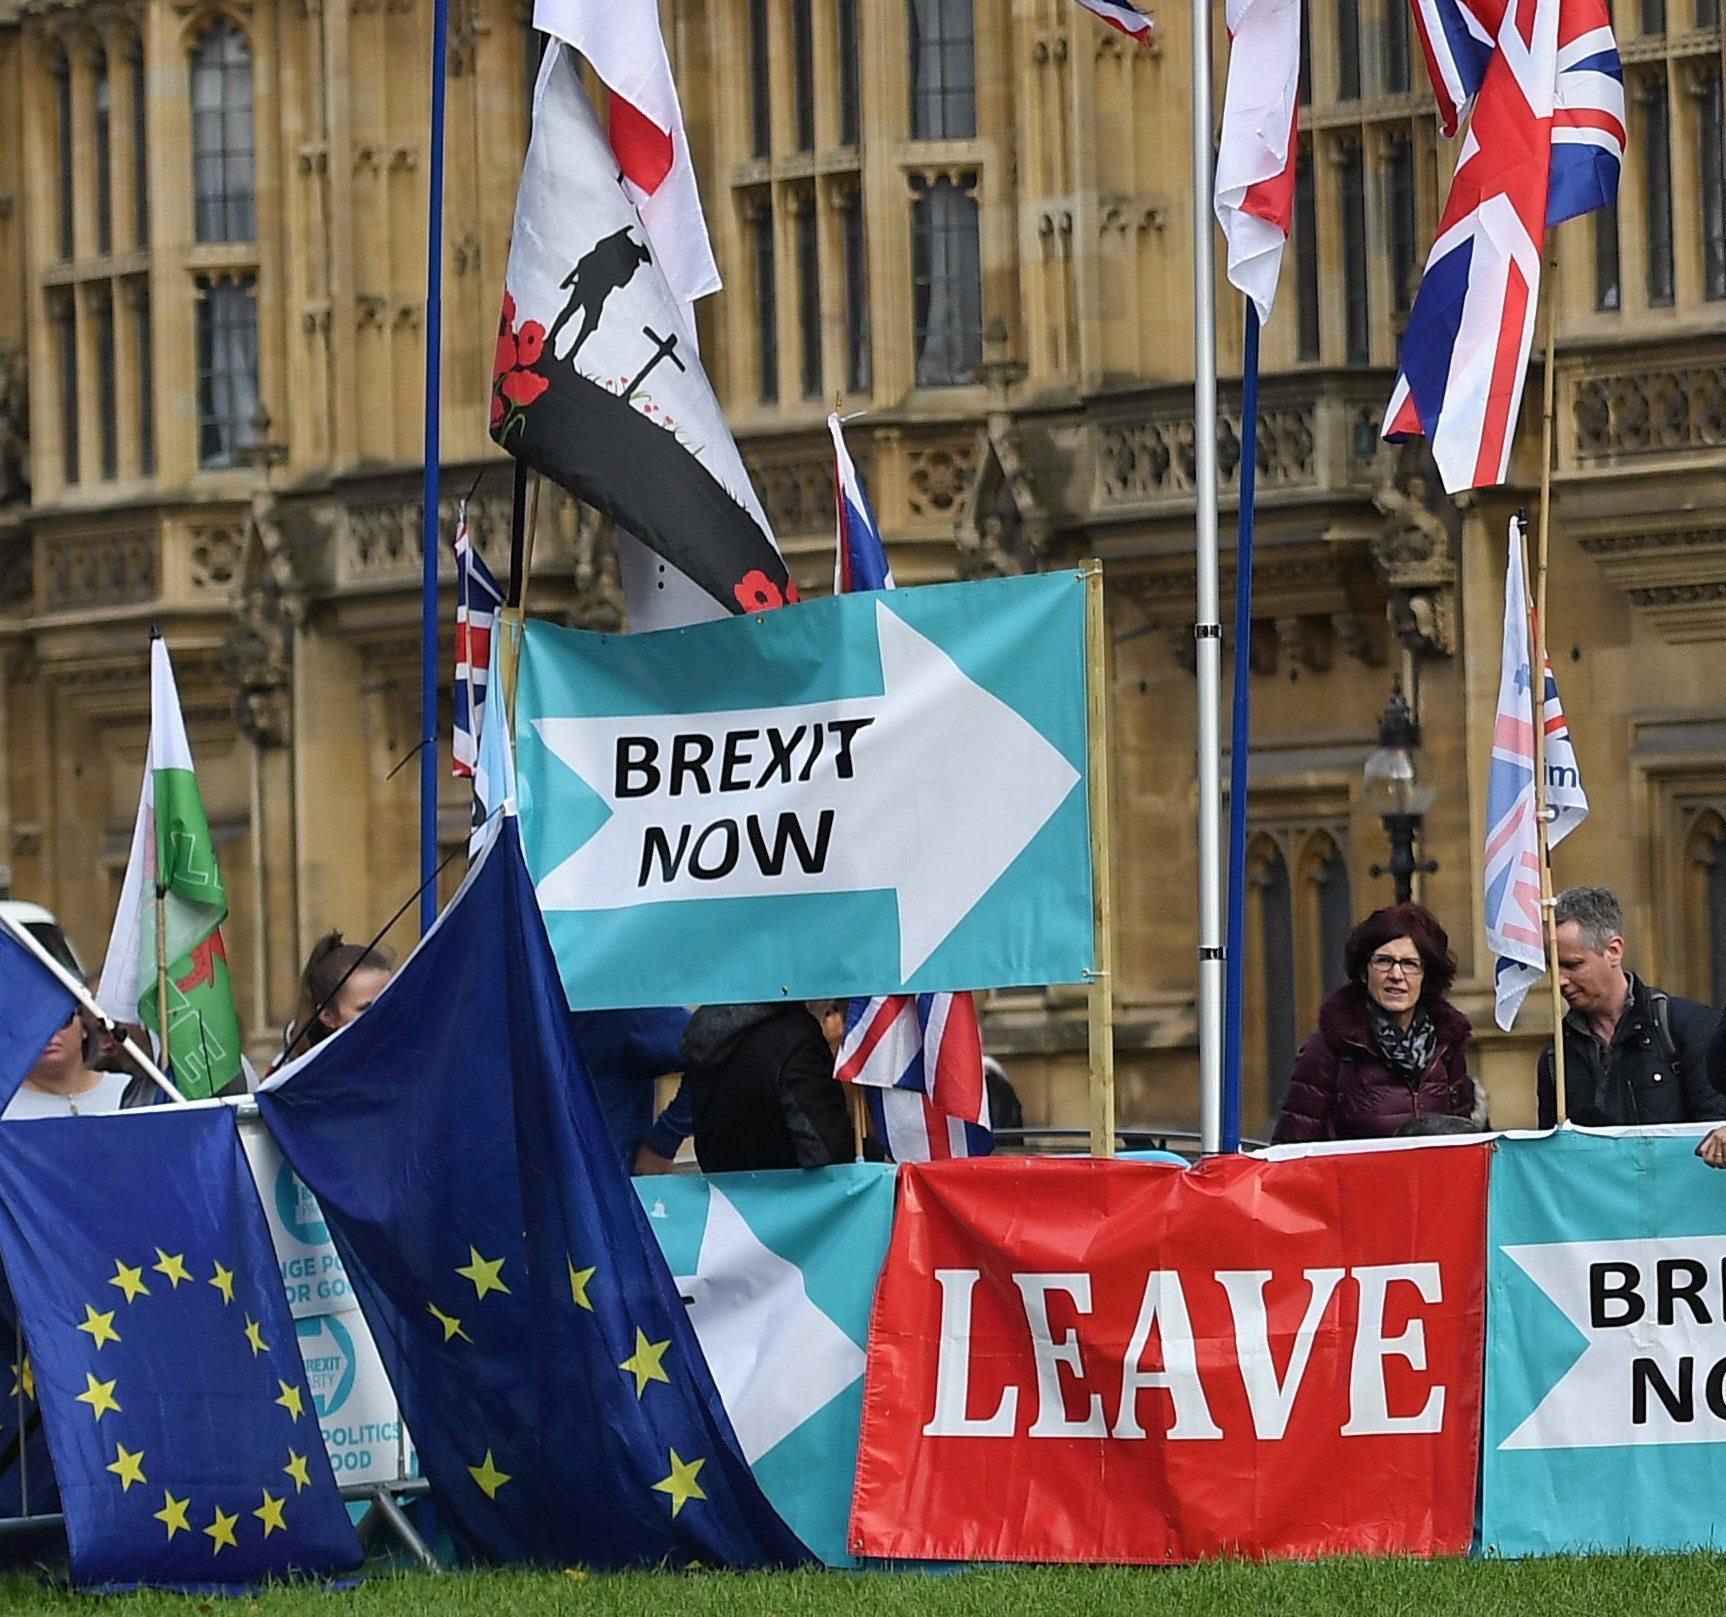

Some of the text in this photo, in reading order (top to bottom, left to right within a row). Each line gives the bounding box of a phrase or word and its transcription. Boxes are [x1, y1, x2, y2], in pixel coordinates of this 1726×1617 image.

[614, 717, 875, 798] BREXIT
[638, 809, 835, 888] NOW
[286, 1284, 311, 1303] OR
[923, 1262, 1445, 1441] LEAVE
[331, 1450, 372, 1472] OOD
